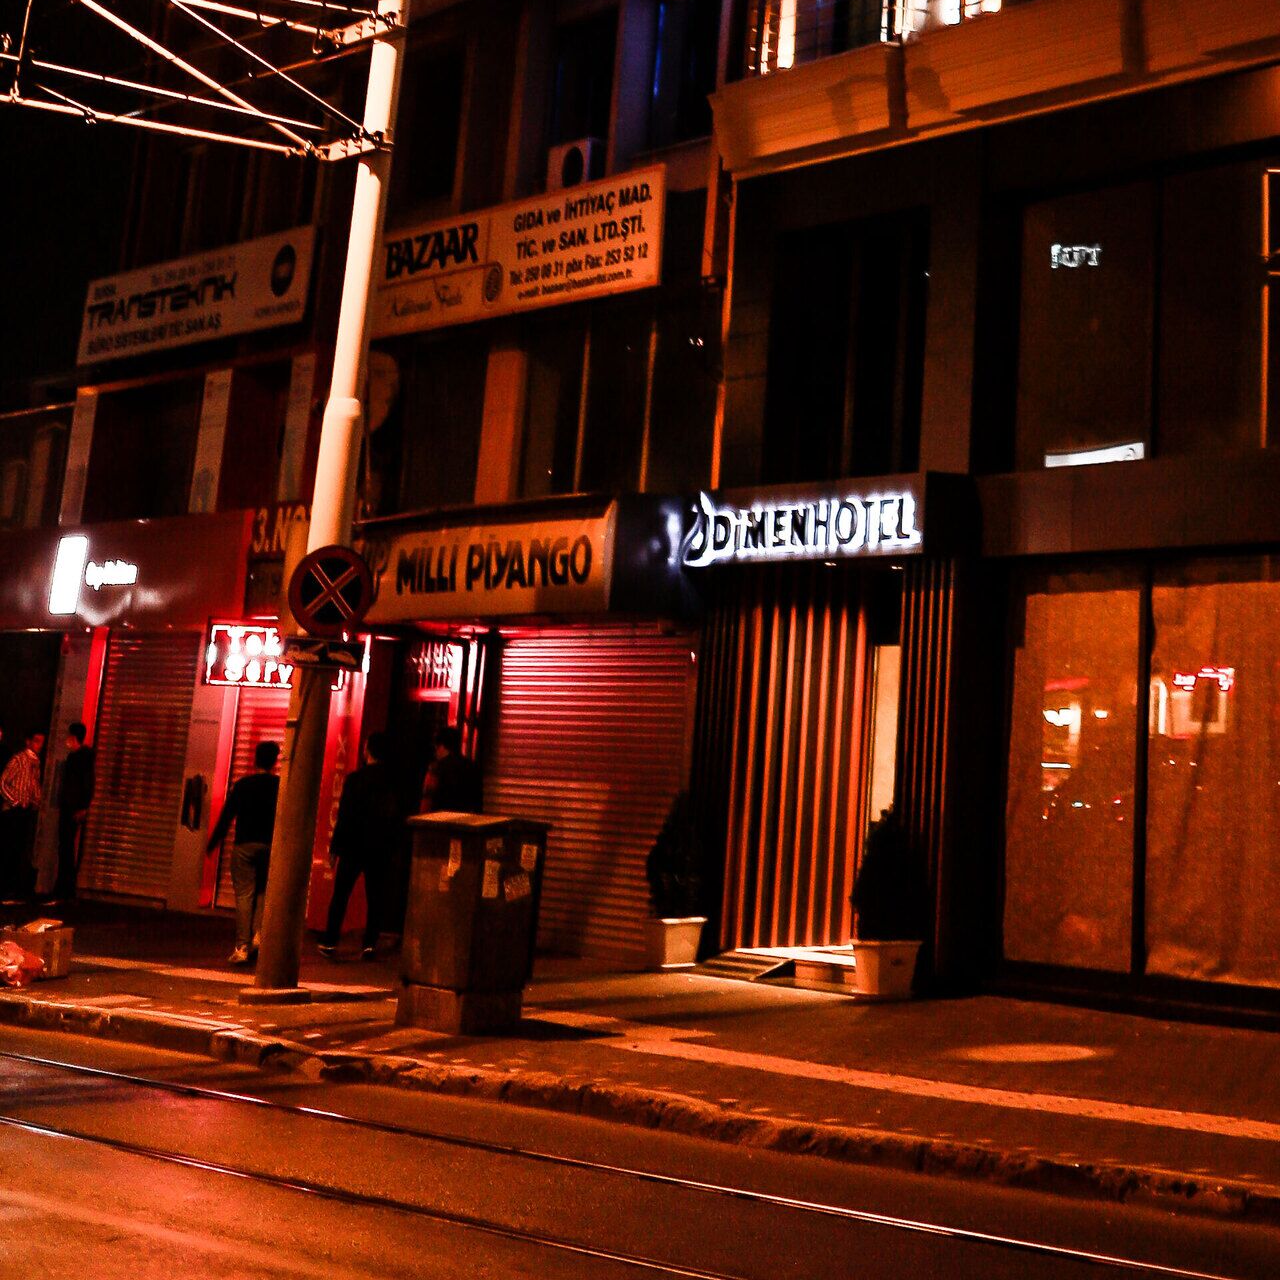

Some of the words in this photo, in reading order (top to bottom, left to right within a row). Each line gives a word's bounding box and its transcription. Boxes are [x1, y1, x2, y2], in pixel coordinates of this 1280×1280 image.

[513, 209, 544, 233] GIDA
[546, 209, 561, 223] ve
[564, 191, 616, 221] İHTİYAÇ
[618, 183, 653, 208] MAD.
[385, 223, 479, 279] BAZAAR
[516, 236, 538, 261] TİC.
[541, 239, 557, 254] ve
[558, 227, 589, 251] SAN.
